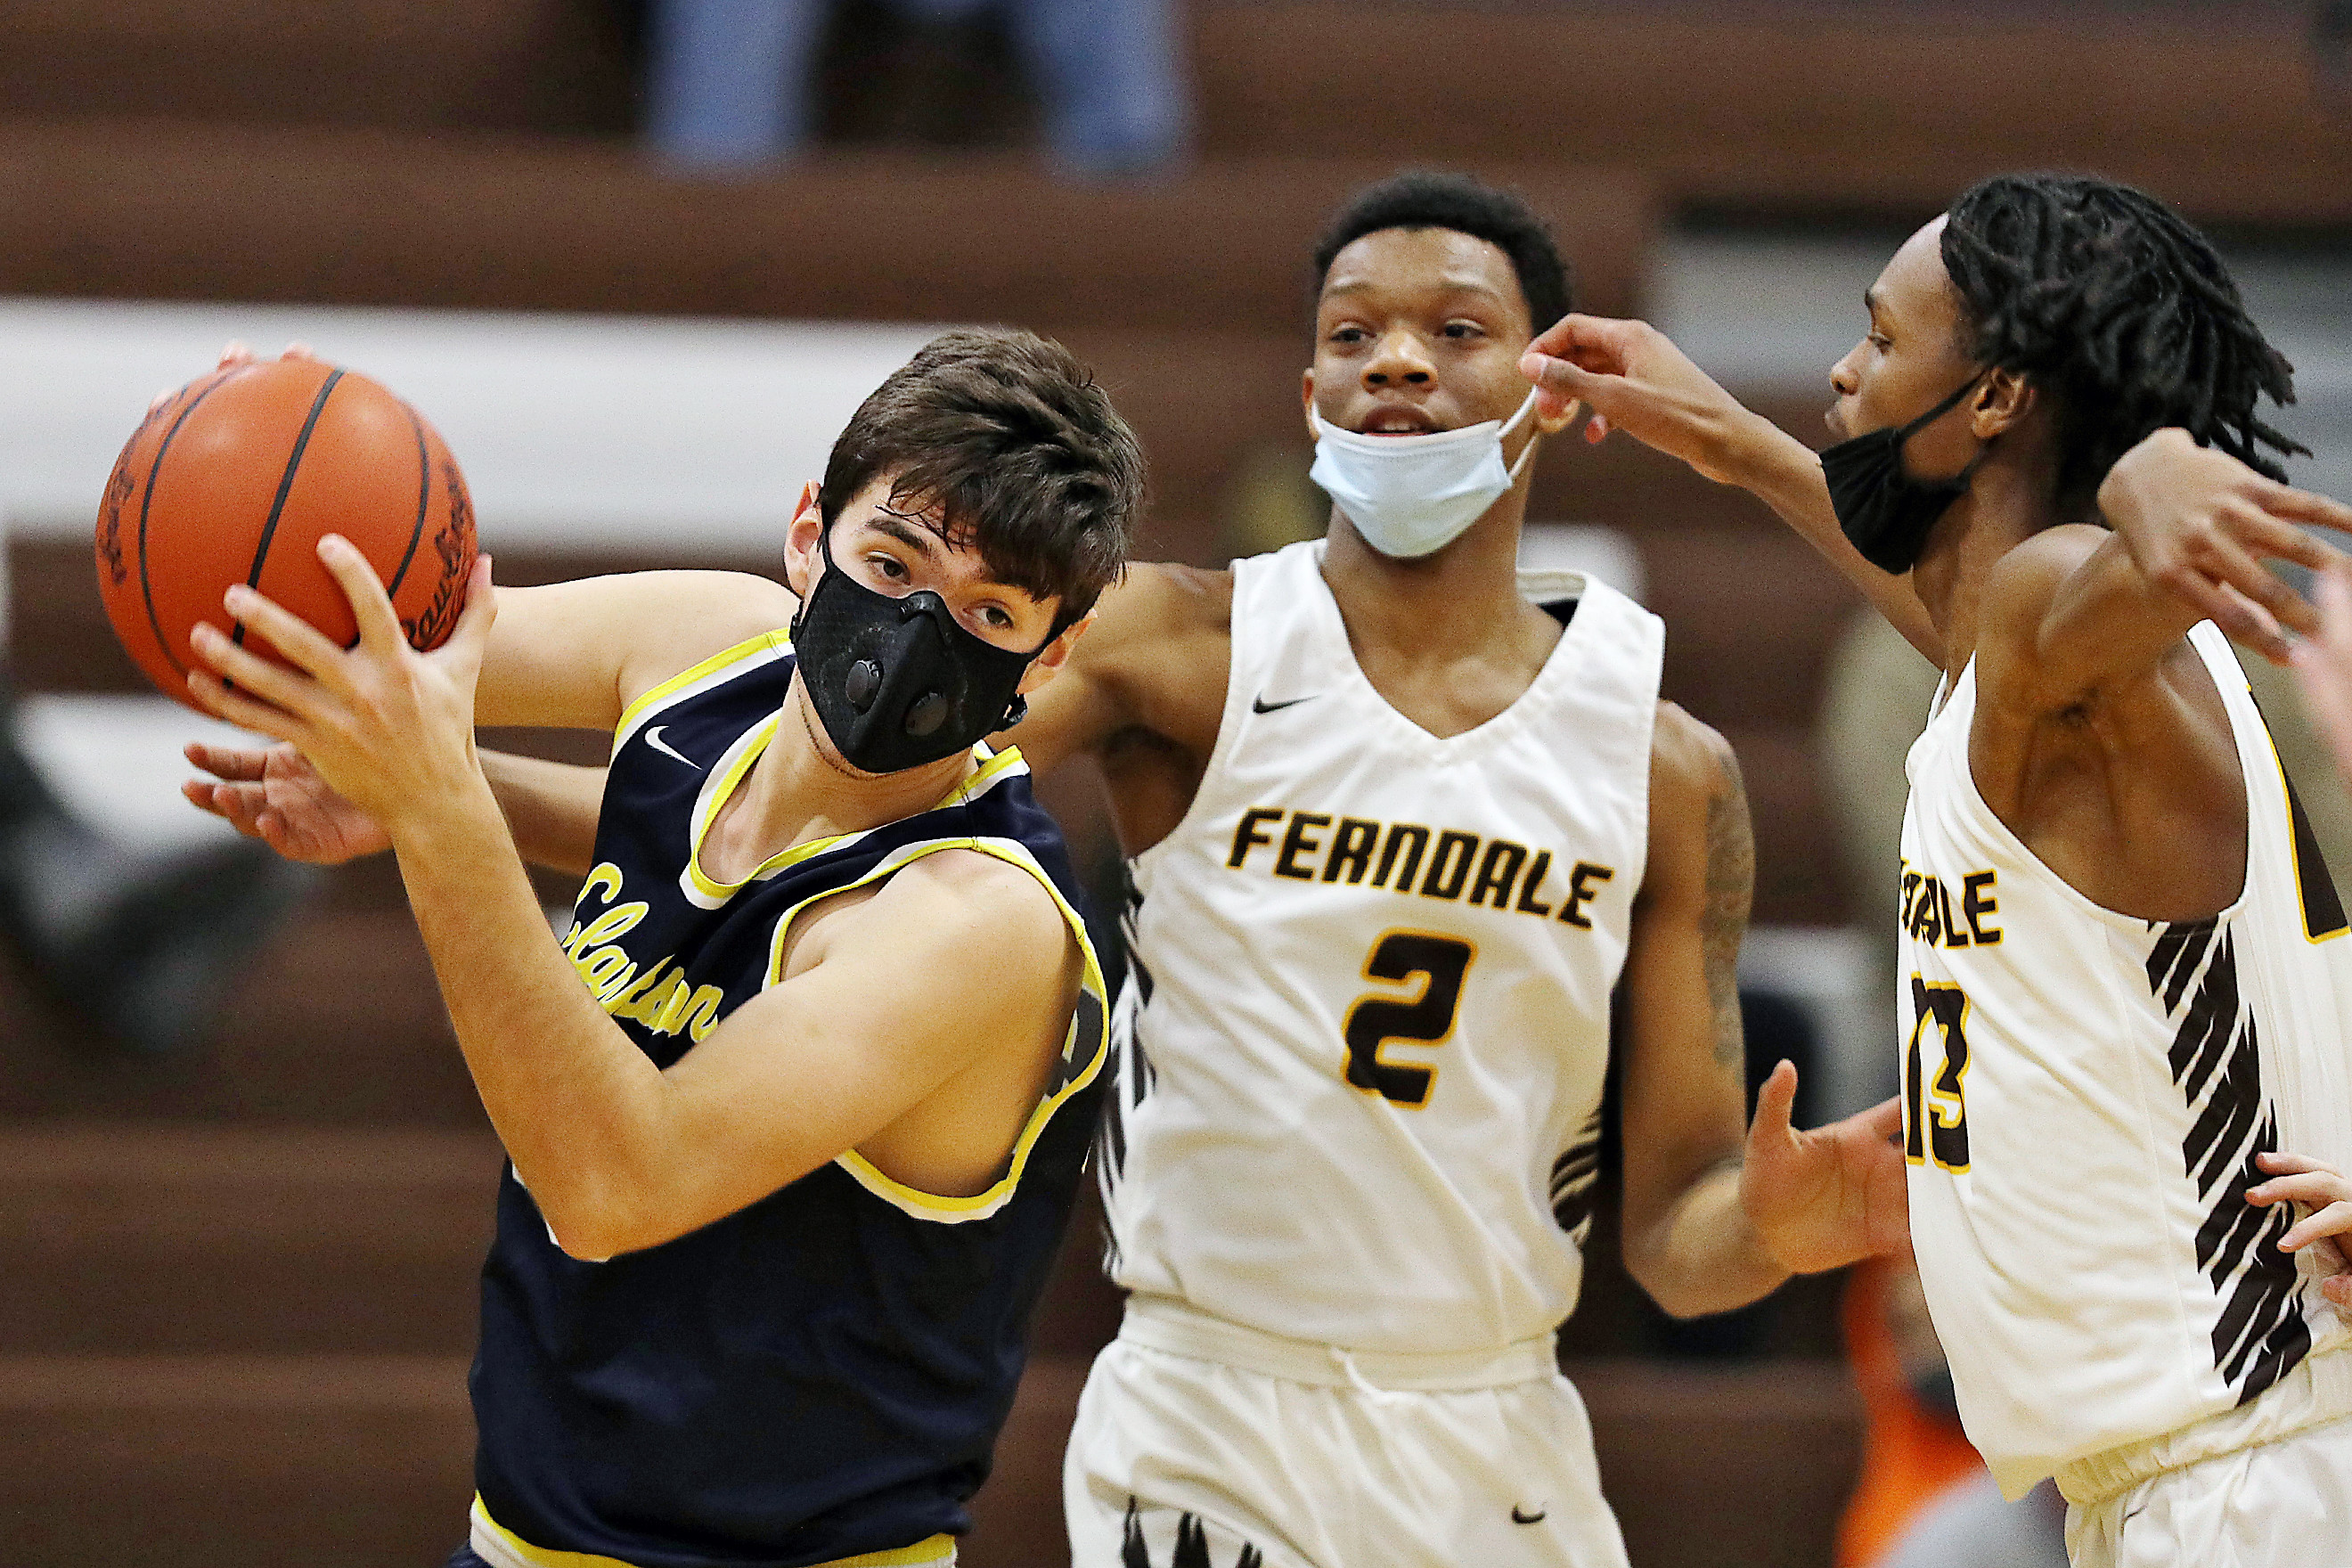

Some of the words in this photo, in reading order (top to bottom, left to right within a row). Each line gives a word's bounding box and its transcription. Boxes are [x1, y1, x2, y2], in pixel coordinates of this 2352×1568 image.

[1226, 804, 1614, 931] FERNDALE
[1340, 927, 1478, 1111] 2
[1906, 971, 1972, 1175] 13
